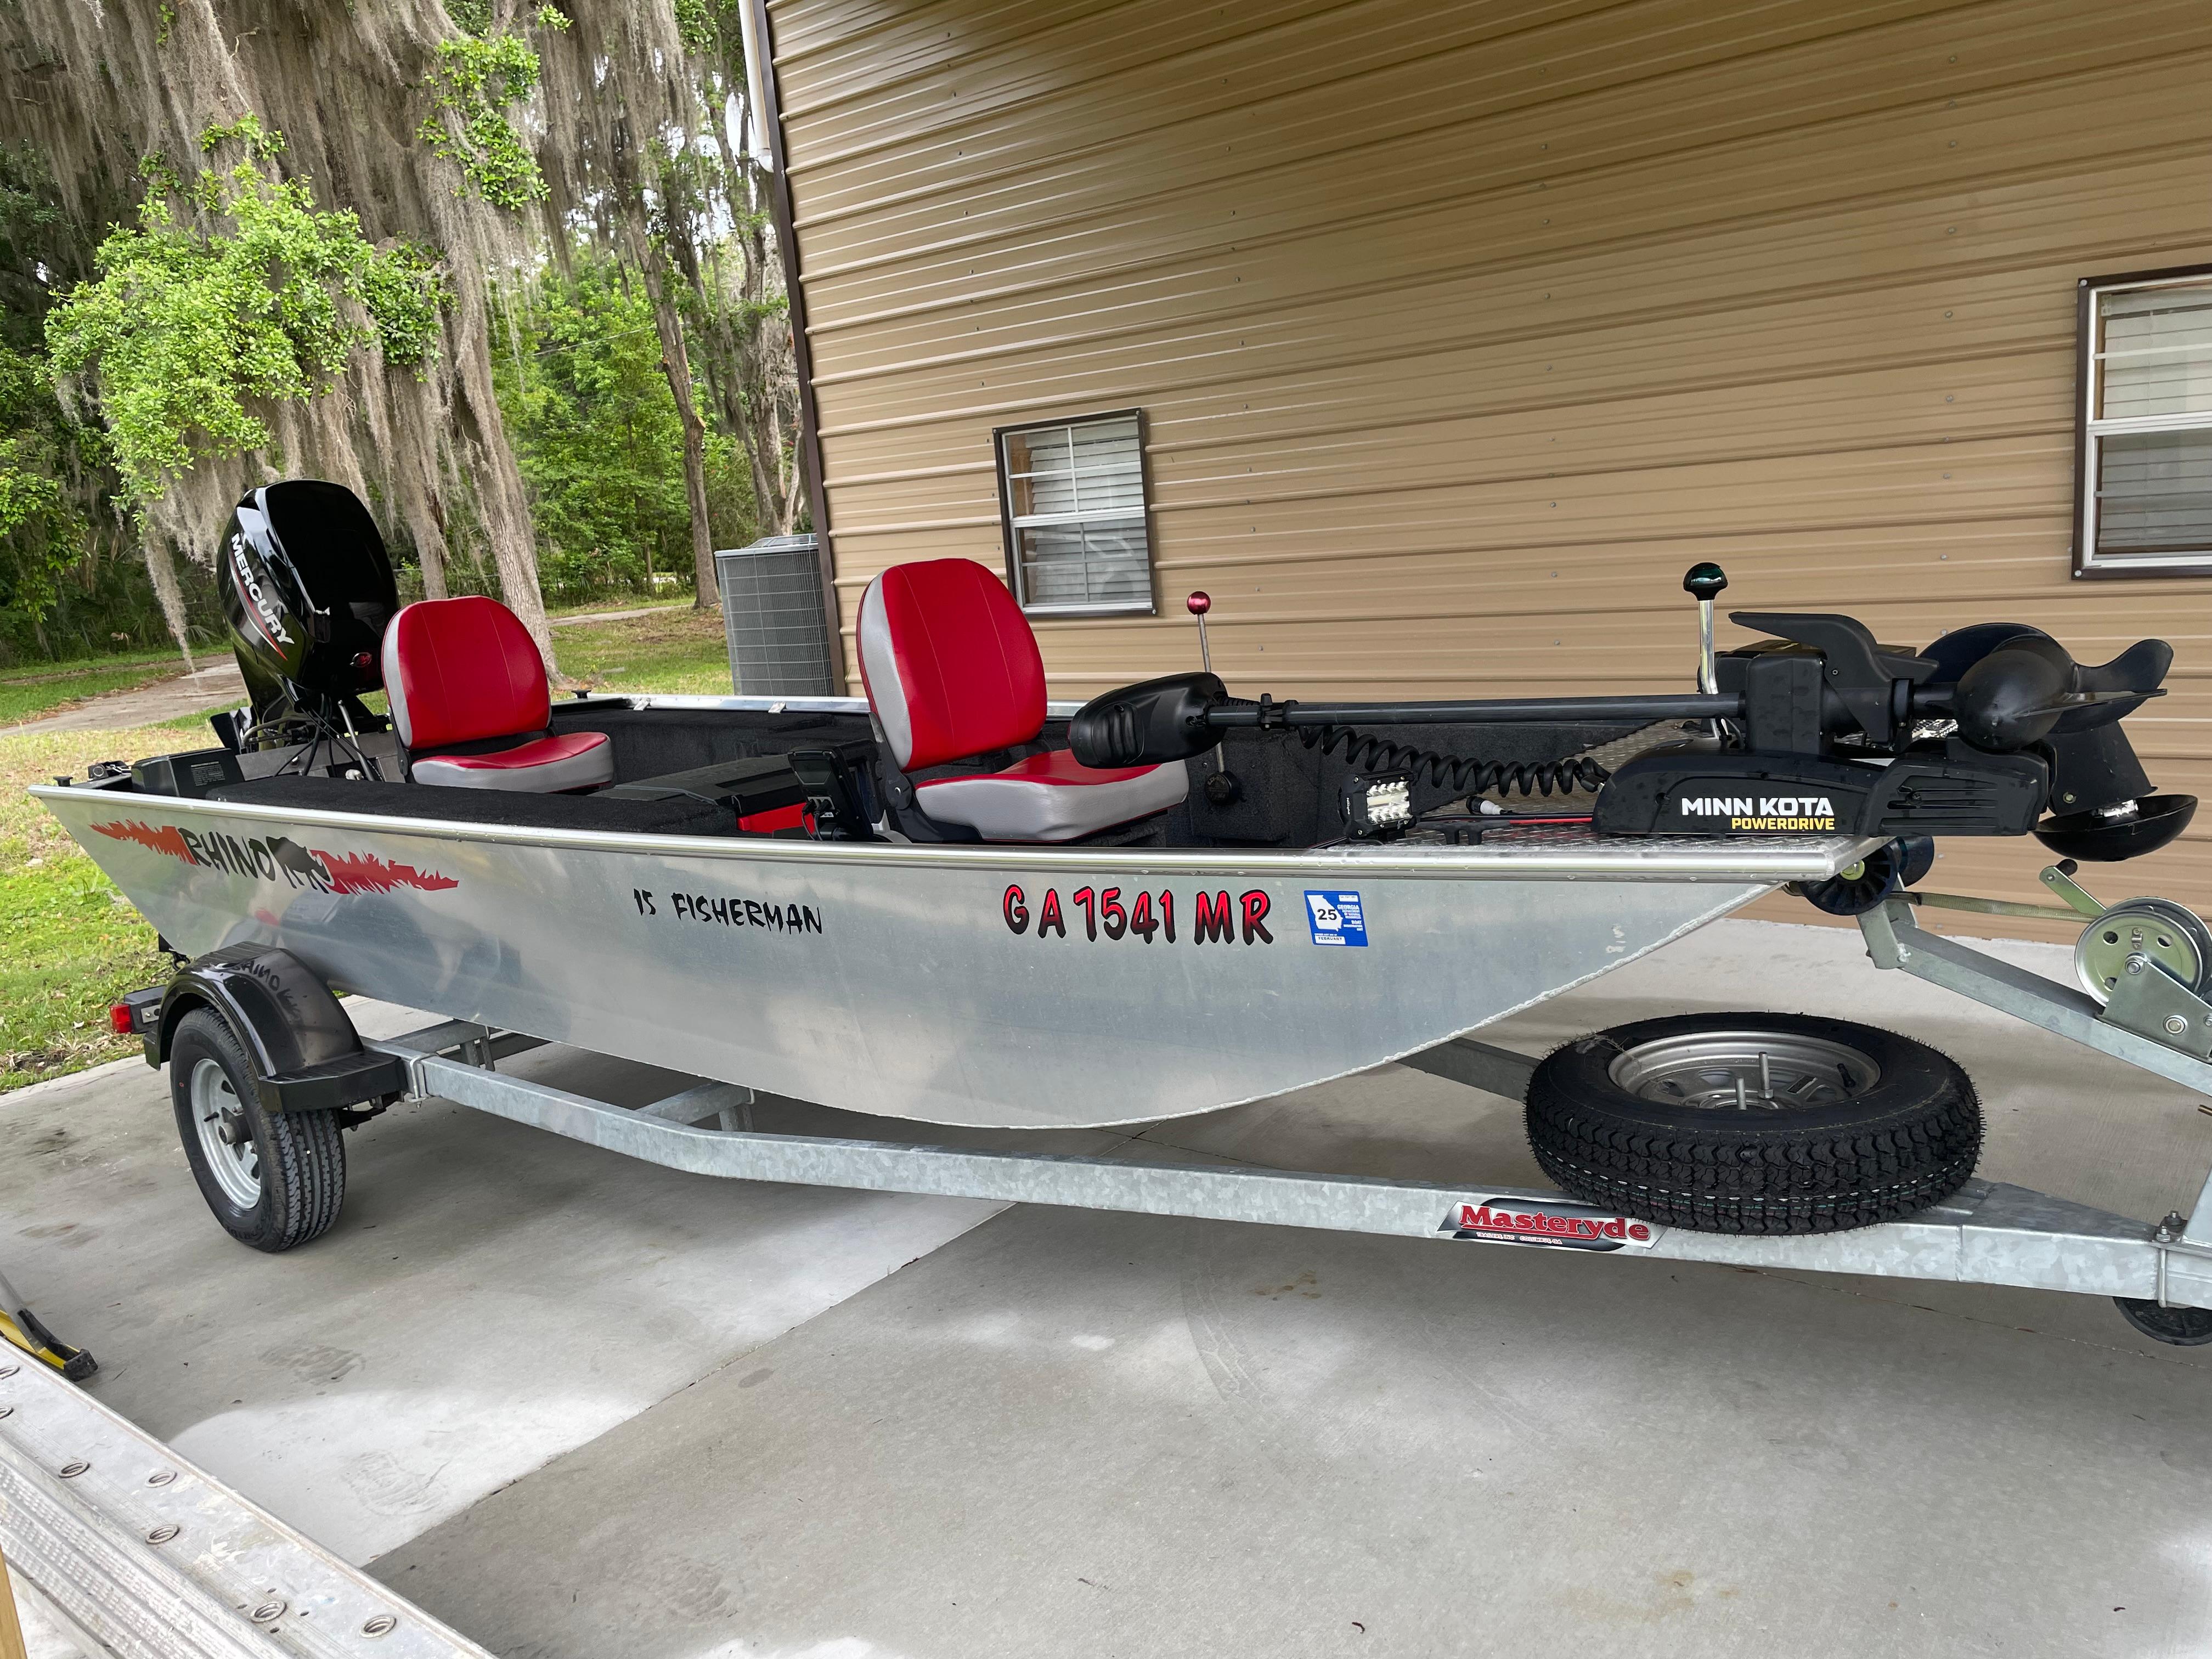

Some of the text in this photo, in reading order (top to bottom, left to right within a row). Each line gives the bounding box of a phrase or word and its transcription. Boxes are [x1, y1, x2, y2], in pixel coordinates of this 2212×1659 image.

[232, 533, 295, 644] MERCURY
[1681, 798, 1833, 816] MINN KOTA
[1731, 818, 1835, 830] POWERDRIVE
[178, 827, 275, 881] RHINO
[634, 888, 822, 934] 15 FISHERMAN
[1194, 889, 1273, 945] MR
[1317, 909, 1338, 921] 25
[1459, 1205, 1651, 1240] Masteryde
